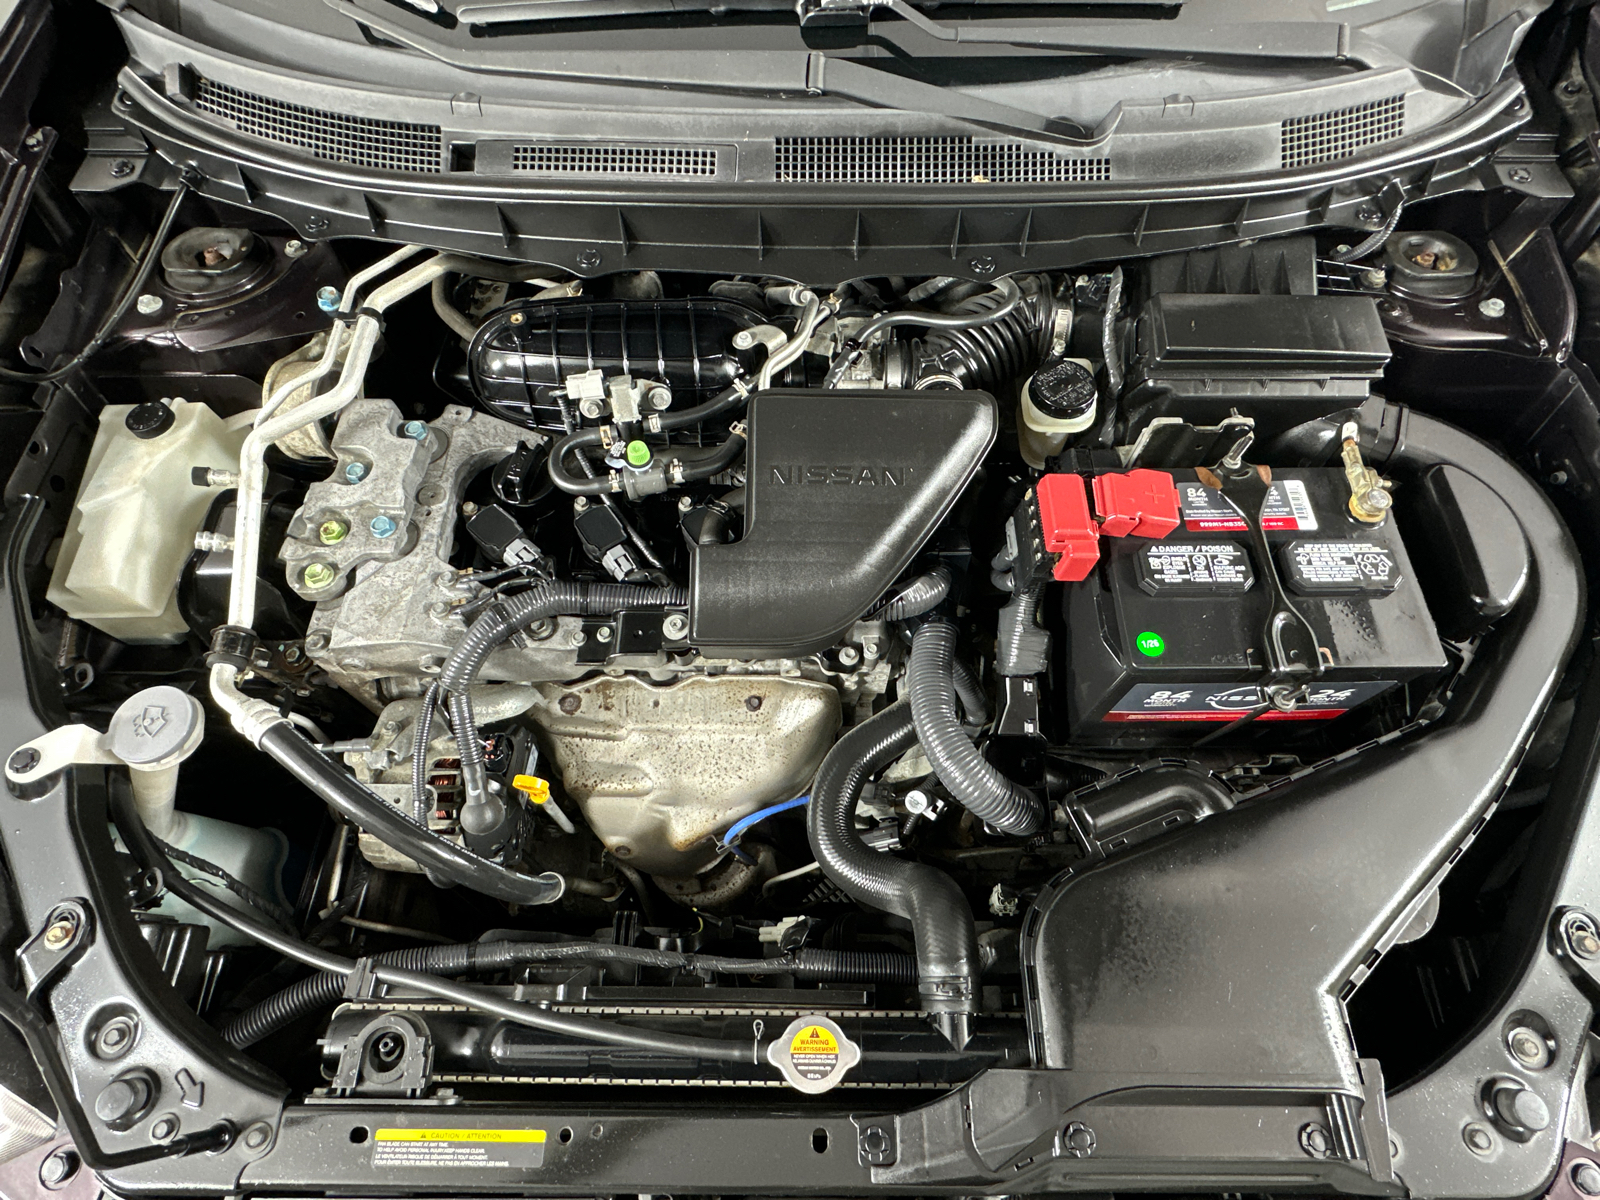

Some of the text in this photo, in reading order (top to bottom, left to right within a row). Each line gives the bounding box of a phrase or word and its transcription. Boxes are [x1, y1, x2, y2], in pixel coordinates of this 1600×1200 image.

[769, 465, 905, 486] NISSAN
[1186, 487, 1207, 497] 84
[1158, 545, 1194, 553] DANGER
[1201, 545, 1234, 553] POISON
[1149, 690, 1194, 699] 84
[1309, 688, 1356, 698] 24
[466, 1132, 502, 1140] ATTENTION
